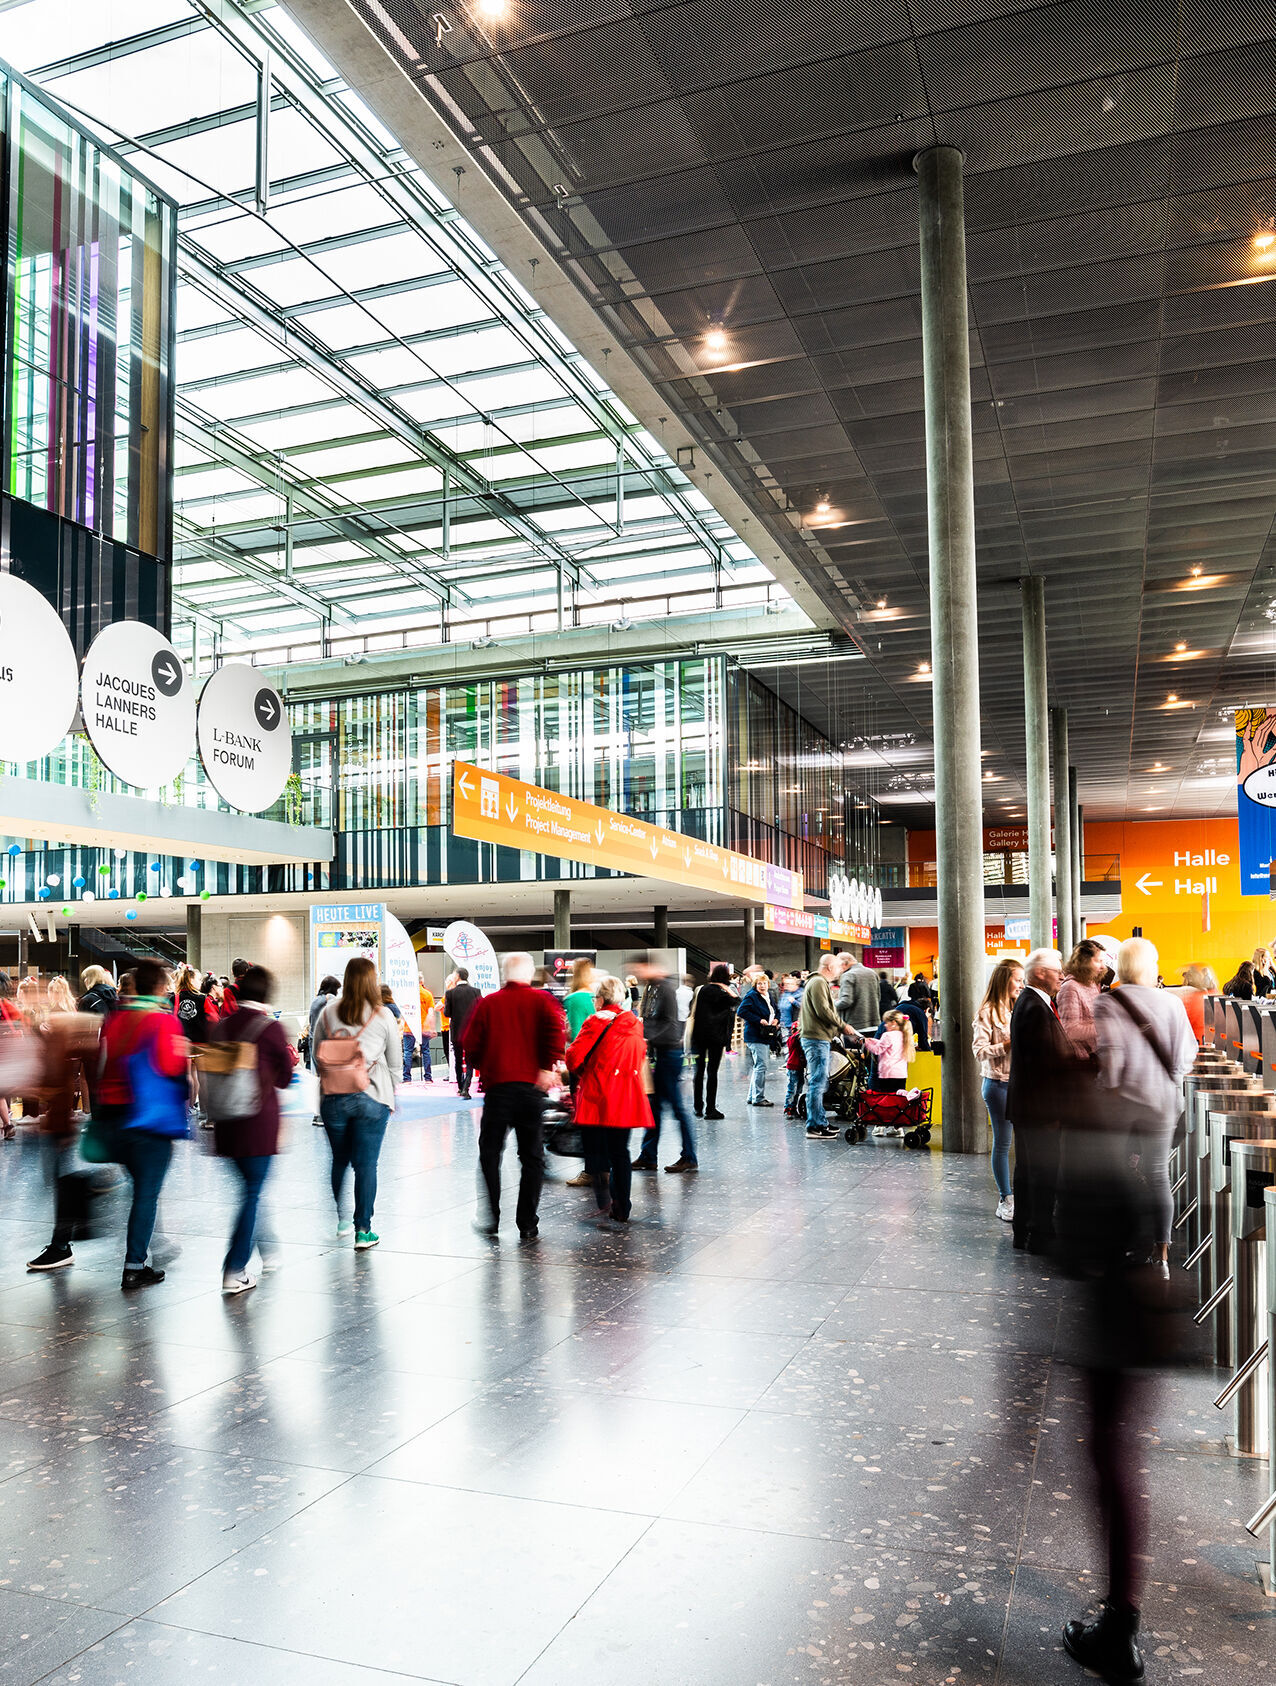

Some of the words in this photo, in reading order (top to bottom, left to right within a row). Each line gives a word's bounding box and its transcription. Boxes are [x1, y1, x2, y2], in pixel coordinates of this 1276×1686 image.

[96, 672, 156, 701] JACQUES
[96, 692, 156, 721] LANNERS
[96, 712, 138, 736] HALLE
[213, 727, 262, 752] L-BANK
[213, 748, 254, 771] FORUM
[526, 791, 571, 821] Projektleitung
[526, 813, 550, 834] Project
[551, 820, 591, 844] Management
[988, 830, 1020, 838] Galerie
[989, 839, 1020, 847] Gallery
[1174, 849, 1231, 867] Halle
[1174, 876, 1217, 895] Hall
[316, 907, 350, 922] HEUTE
[355, 905, 379, 919] LIVE
[389, 956, 410, 968] enjoy
[475, 962, 493, 972] enjoy
[391, 968, 409, 977] your
[477, 972, 492, 980] your
